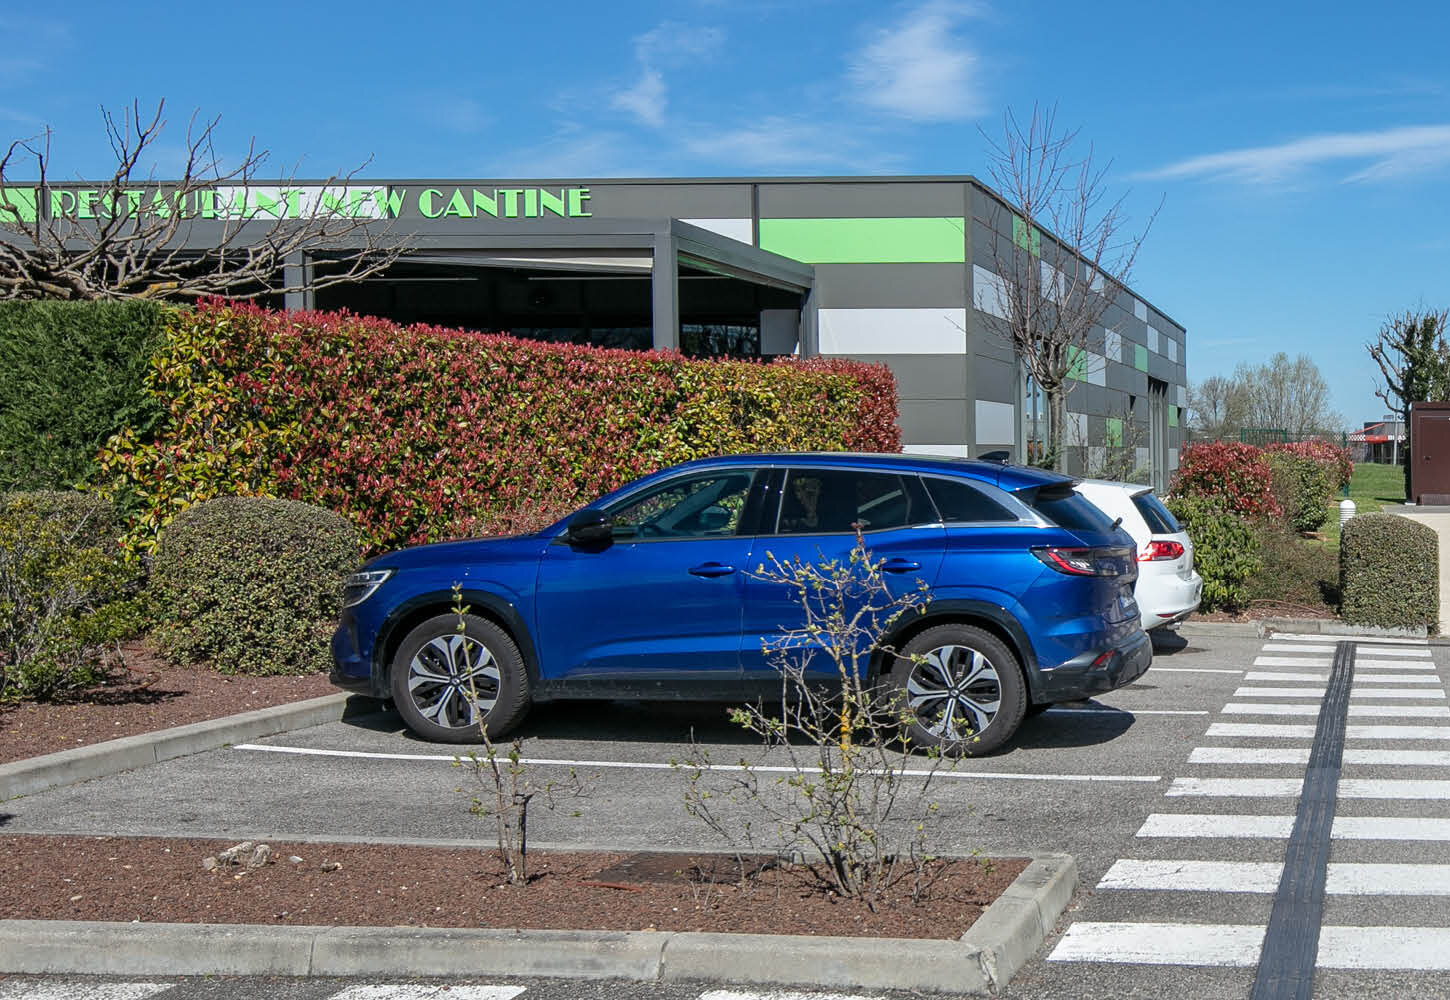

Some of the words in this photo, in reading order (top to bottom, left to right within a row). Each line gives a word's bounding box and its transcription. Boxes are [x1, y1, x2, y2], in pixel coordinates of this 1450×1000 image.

[51, 189, 304, 219] RESTAURANT
[319, 189, 406, 218] NEW
[418, 188, 593, 218] CANTINE
